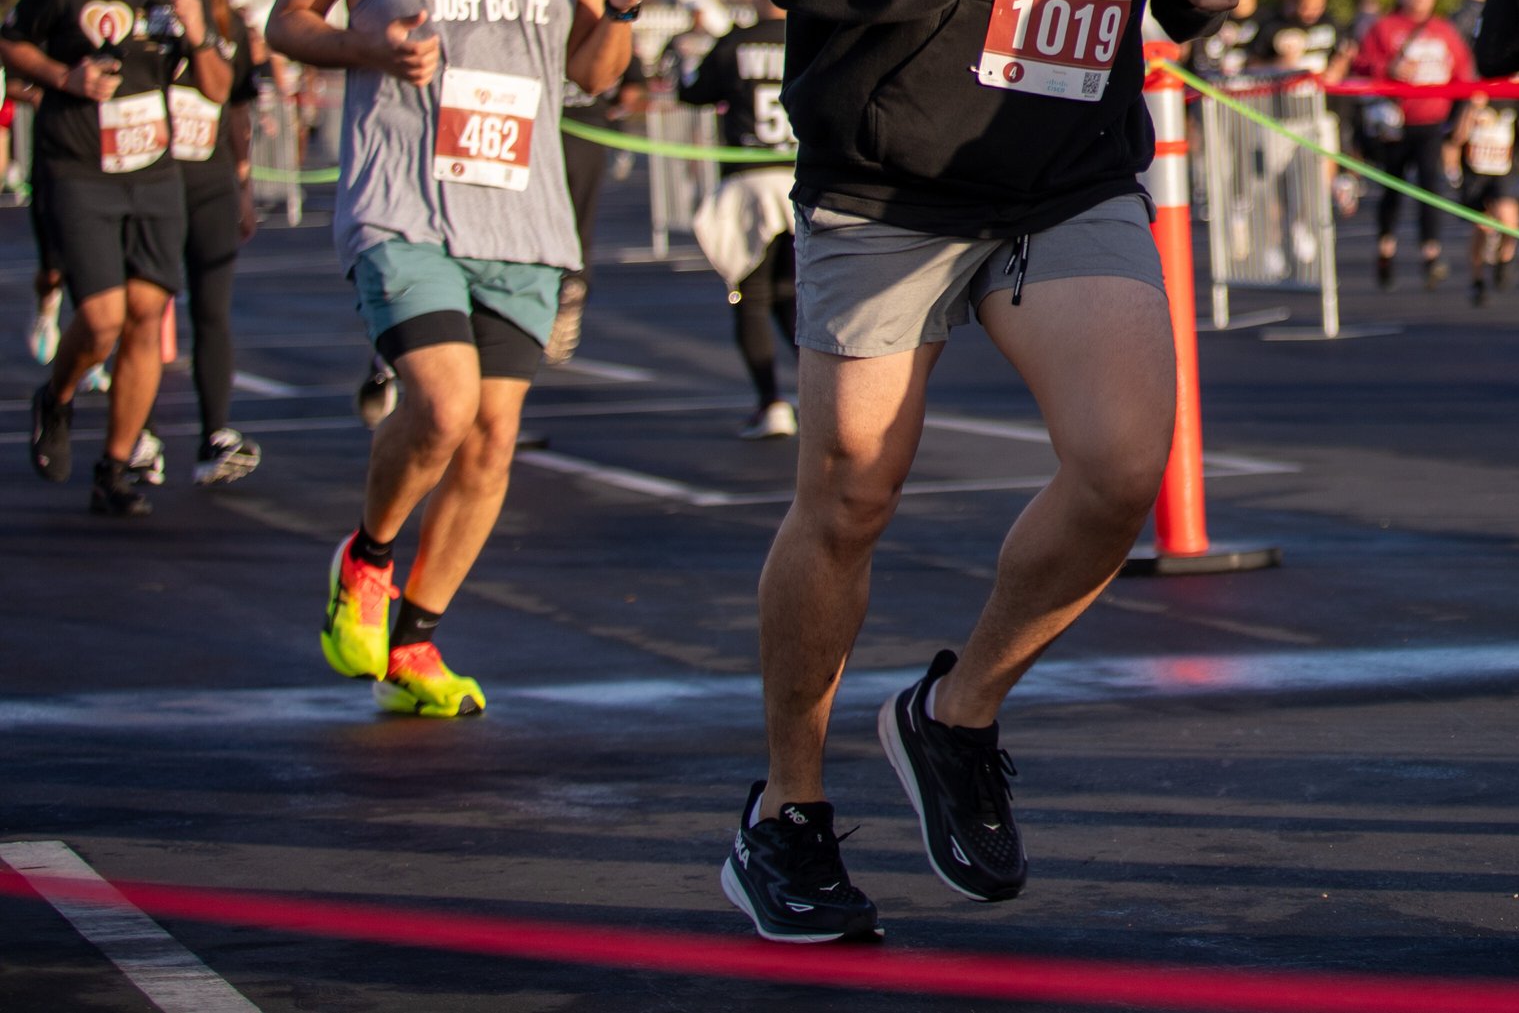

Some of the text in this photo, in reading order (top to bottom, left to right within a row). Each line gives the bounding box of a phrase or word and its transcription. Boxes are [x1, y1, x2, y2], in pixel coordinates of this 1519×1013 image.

[1009, 65, 1018, 80] 4
[116, 124, 158, 156] 962
[458, 114, 520, 162] 462
